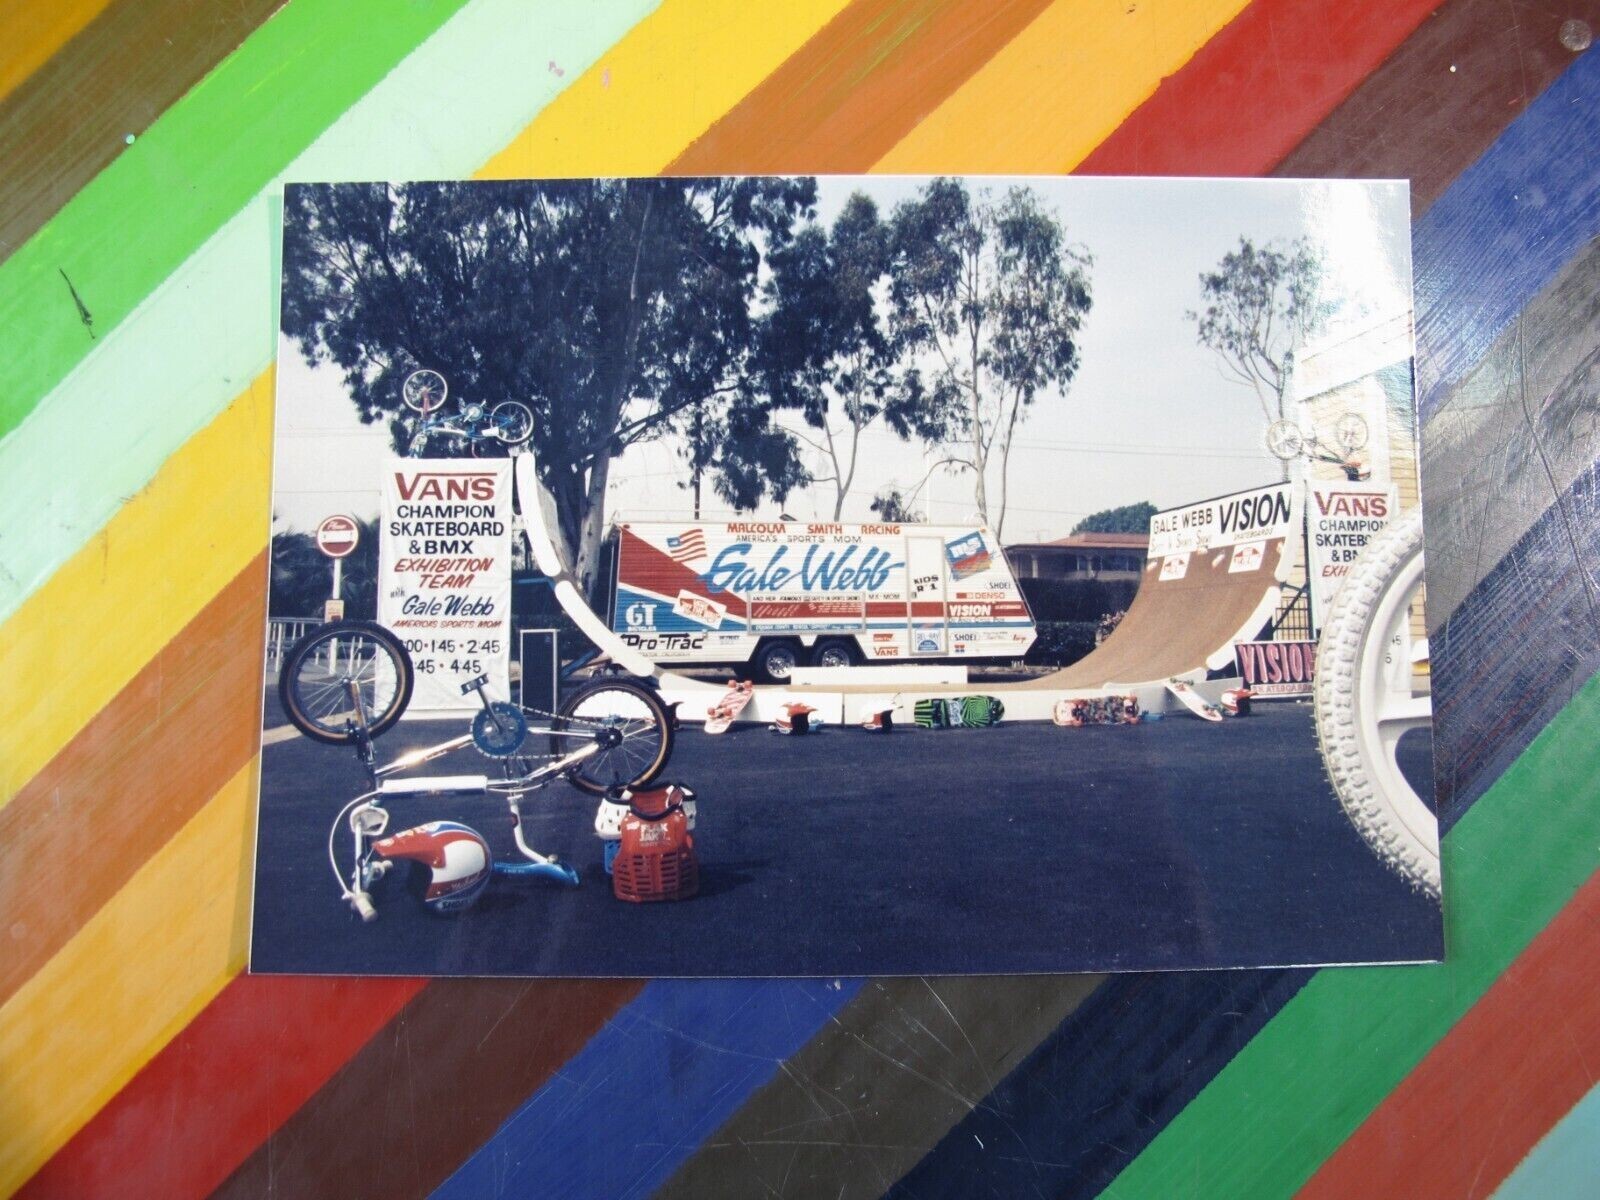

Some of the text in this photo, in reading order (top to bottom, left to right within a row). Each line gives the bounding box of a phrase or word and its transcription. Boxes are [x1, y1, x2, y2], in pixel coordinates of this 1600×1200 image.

[397, 505, 496, 519] CHAMPION
[1219, 491, 1292, 534] VISION
[1153, 507, 1213, 535] GALE WEBB
[390, 521, 505, 537] SKATEBOARD
[727, 523, 901, 535] MALCOLM SMITH RACING
[787, 535, 825, 543] SPORTS
[833, 535, 863, 543] MOM
[424, 540, 474, 554] BMX
[393, 558, 494, 573] EXHIBITION
[696, 543, 800, 594] Gale
[800, 544, 906, 592] Webb
[418, 574, 475, 589] TEAM
[913, 576, 939, 584] KIDS
[402, 594, 495, 616] Gale Webb
[949, 604, 992, 617] VISION
[625, 603, 657, 626] GT
[440, 620, 475, 629] SPORTS
[477, 620, 503, 629] MOM
[620, 631, 705, 650] Pro-Trac
